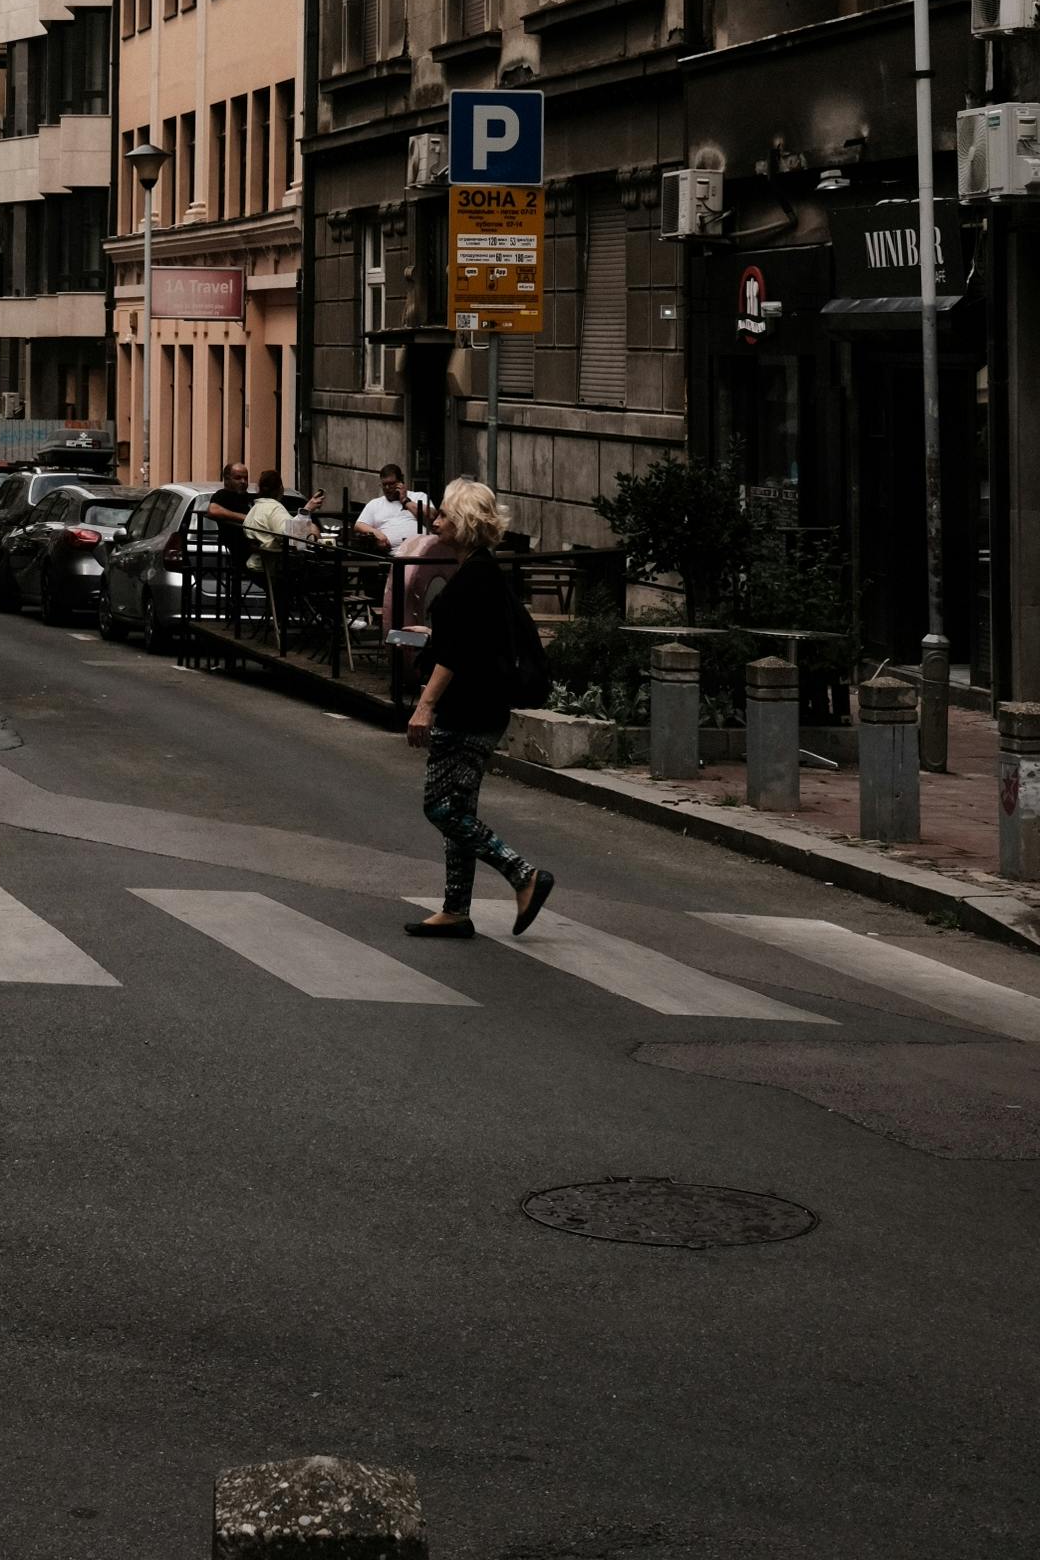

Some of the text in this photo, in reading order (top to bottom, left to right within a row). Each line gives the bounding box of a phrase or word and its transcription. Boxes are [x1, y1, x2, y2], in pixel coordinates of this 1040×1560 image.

[472, 104, 520, 170] P
[458, 190, 537, 208] ЗОНА 2
[864, 226, 944, 268] MINI BR
[189, 279, 233, 294] Travel
